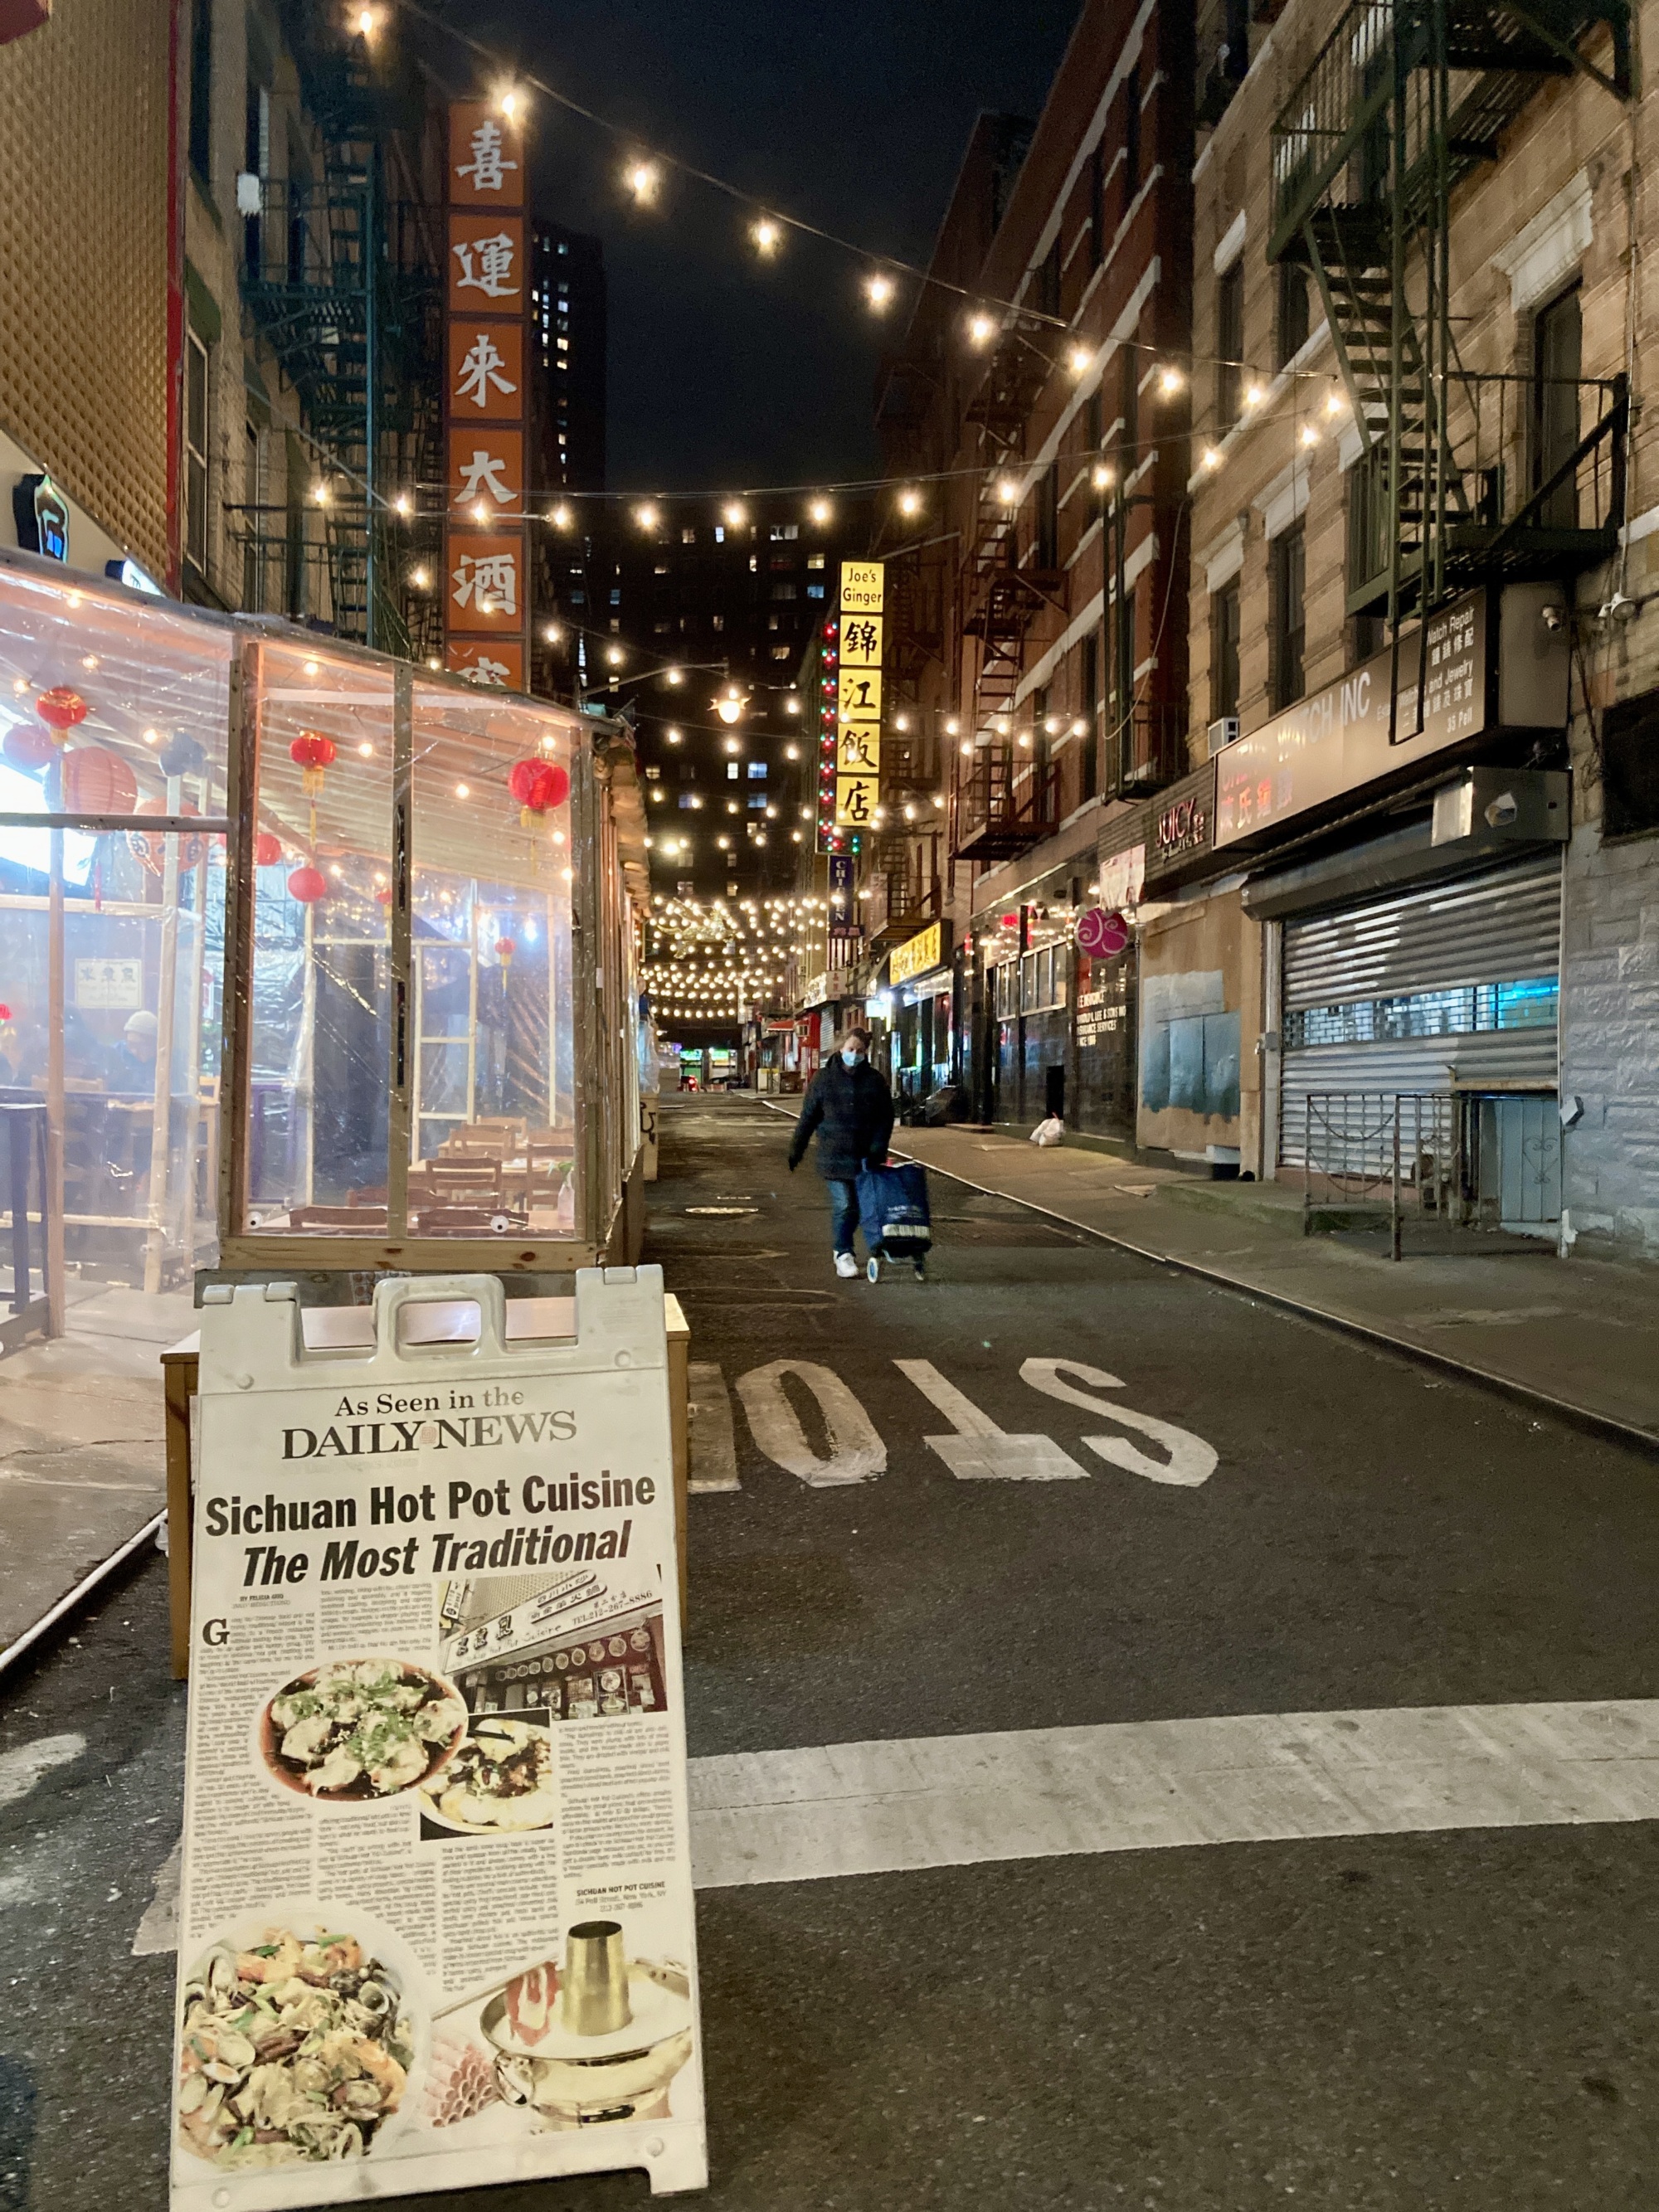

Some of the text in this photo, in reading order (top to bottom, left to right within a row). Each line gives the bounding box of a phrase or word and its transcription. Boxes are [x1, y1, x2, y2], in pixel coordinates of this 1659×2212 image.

[843, 587, 882, 605] Ginger
[849, 567, 877, 582] Joe's
[1449, 605, 1475, 634] Repair
[1340, 671, 1370, 727] INC
[1429, 672, 1443, 694] and
[1444, 659, 1473, 685] Jewelry
[839, 620, 878, 822] 錦江飯店
[1155, 797, 1194, 848] JUICY
[834, 860, 847, 921] CHICEN
[334, 1386, 525, 1417] As Seen in the
[281, 1410, 577, 1460] DAILY NEWS
[205, 1470, 656, 1537] Sichuan Hot Pot Cuisine
[242, 1519, 633, 1587] The Most Traditional
[577, 1881, 665, 1897] SICHUAN HOT POT CUISINE
